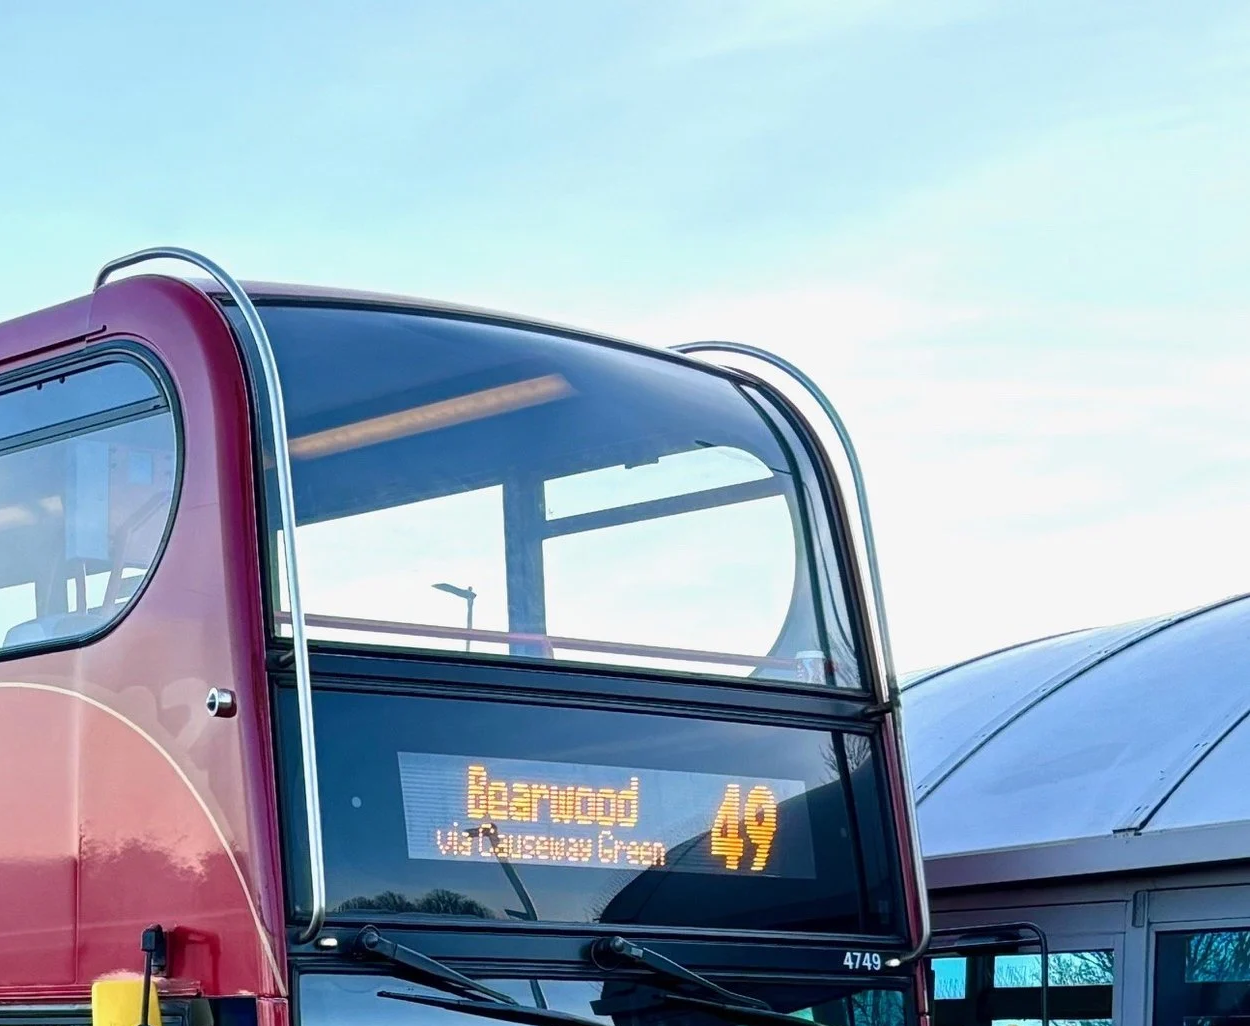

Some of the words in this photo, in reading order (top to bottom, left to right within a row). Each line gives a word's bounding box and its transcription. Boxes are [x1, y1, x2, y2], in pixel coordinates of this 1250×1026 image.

[467, 765, 639, 828] Bearwood
[436, 821, 472, 856] via
[478, 823, 593, 862] Causeway
[598, 830, 666, 867] Green
[711, 783, 777, 870] 49
[842, 951, 882, 971] 4749
